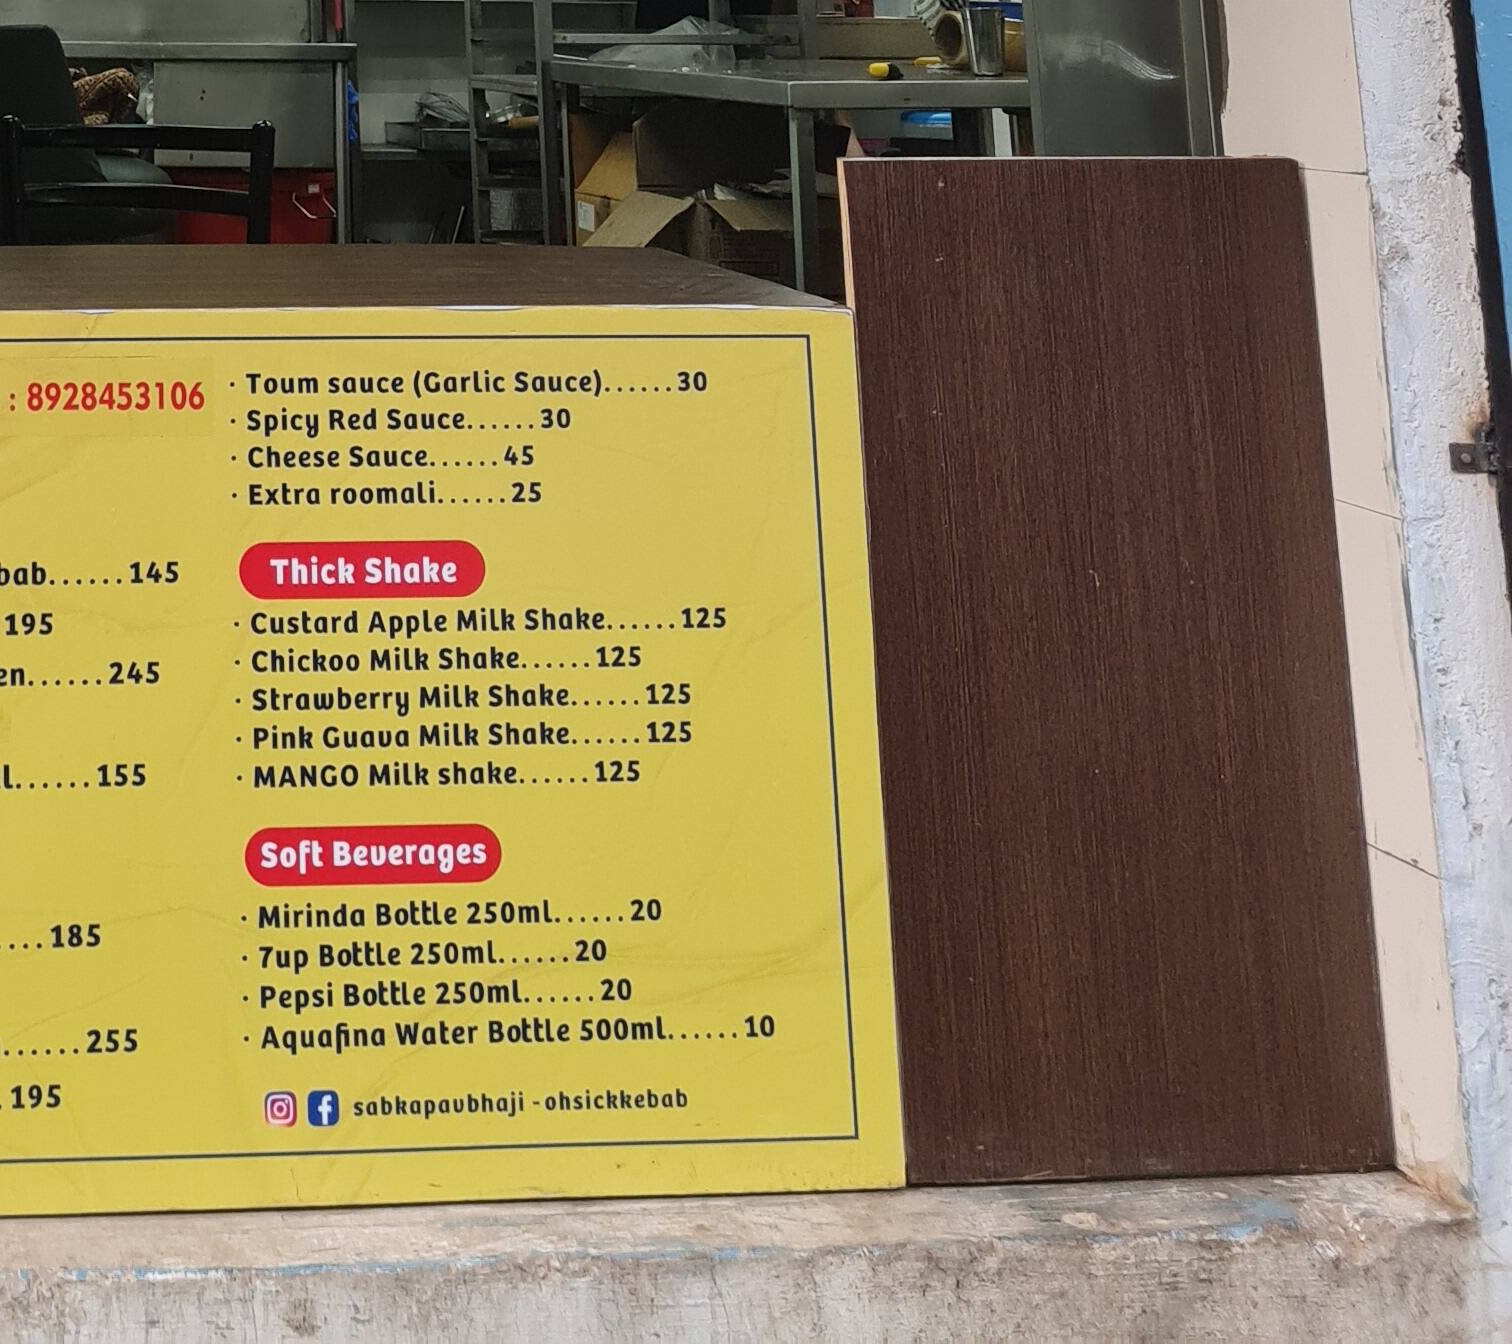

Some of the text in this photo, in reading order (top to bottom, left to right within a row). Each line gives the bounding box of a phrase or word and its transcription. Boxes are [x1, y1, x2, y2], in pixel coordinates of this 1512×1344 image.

[26, 380, 206, 413] 8928453106
[245, 373, 319, 395] Toum
[328, 376, 404, 394] sauce
[413, 369, 506, 399] (Garlic
[247, 407, 319, 439] Spicy
[328, 407, 377, 431] Red
[247, 445, 340, 469] Cheese
[248, 482, 321, 506] Extra
[269, 555, 458, 586] Thick Shake
[250, 610, 359, 635] Custard
[368, 609, 447, 640] Apple
[457, 607, 516, 632] Milk
[252, 686, 410, 717] Strawberry
[419, 683, 480, 709] Milk
[253, 724, 314, 750] Pink
[322, 726, 410, 749] Guava
[419, 721, 479, 747] Milk
[254, 764, 359, 788] MANGO
[369, 761, 429, 787] Milk
[259, 839, 488, 875] Soft Beverages
[258, 902, 365, 929] Mirinda
[375, 900, 457, 927] Bottle
[258, 946, 309, 975] 7up
[319, 941, 401, 967] Bottle
[260, 981, 333, 1015] Pepsi
[343, 980, 426, 1007] Bottle
[261, 1022, 386, 1056] Aquafina
[395, 1020, 478, 1046] Water
[488, 1017, 570, 1044] Bottle
